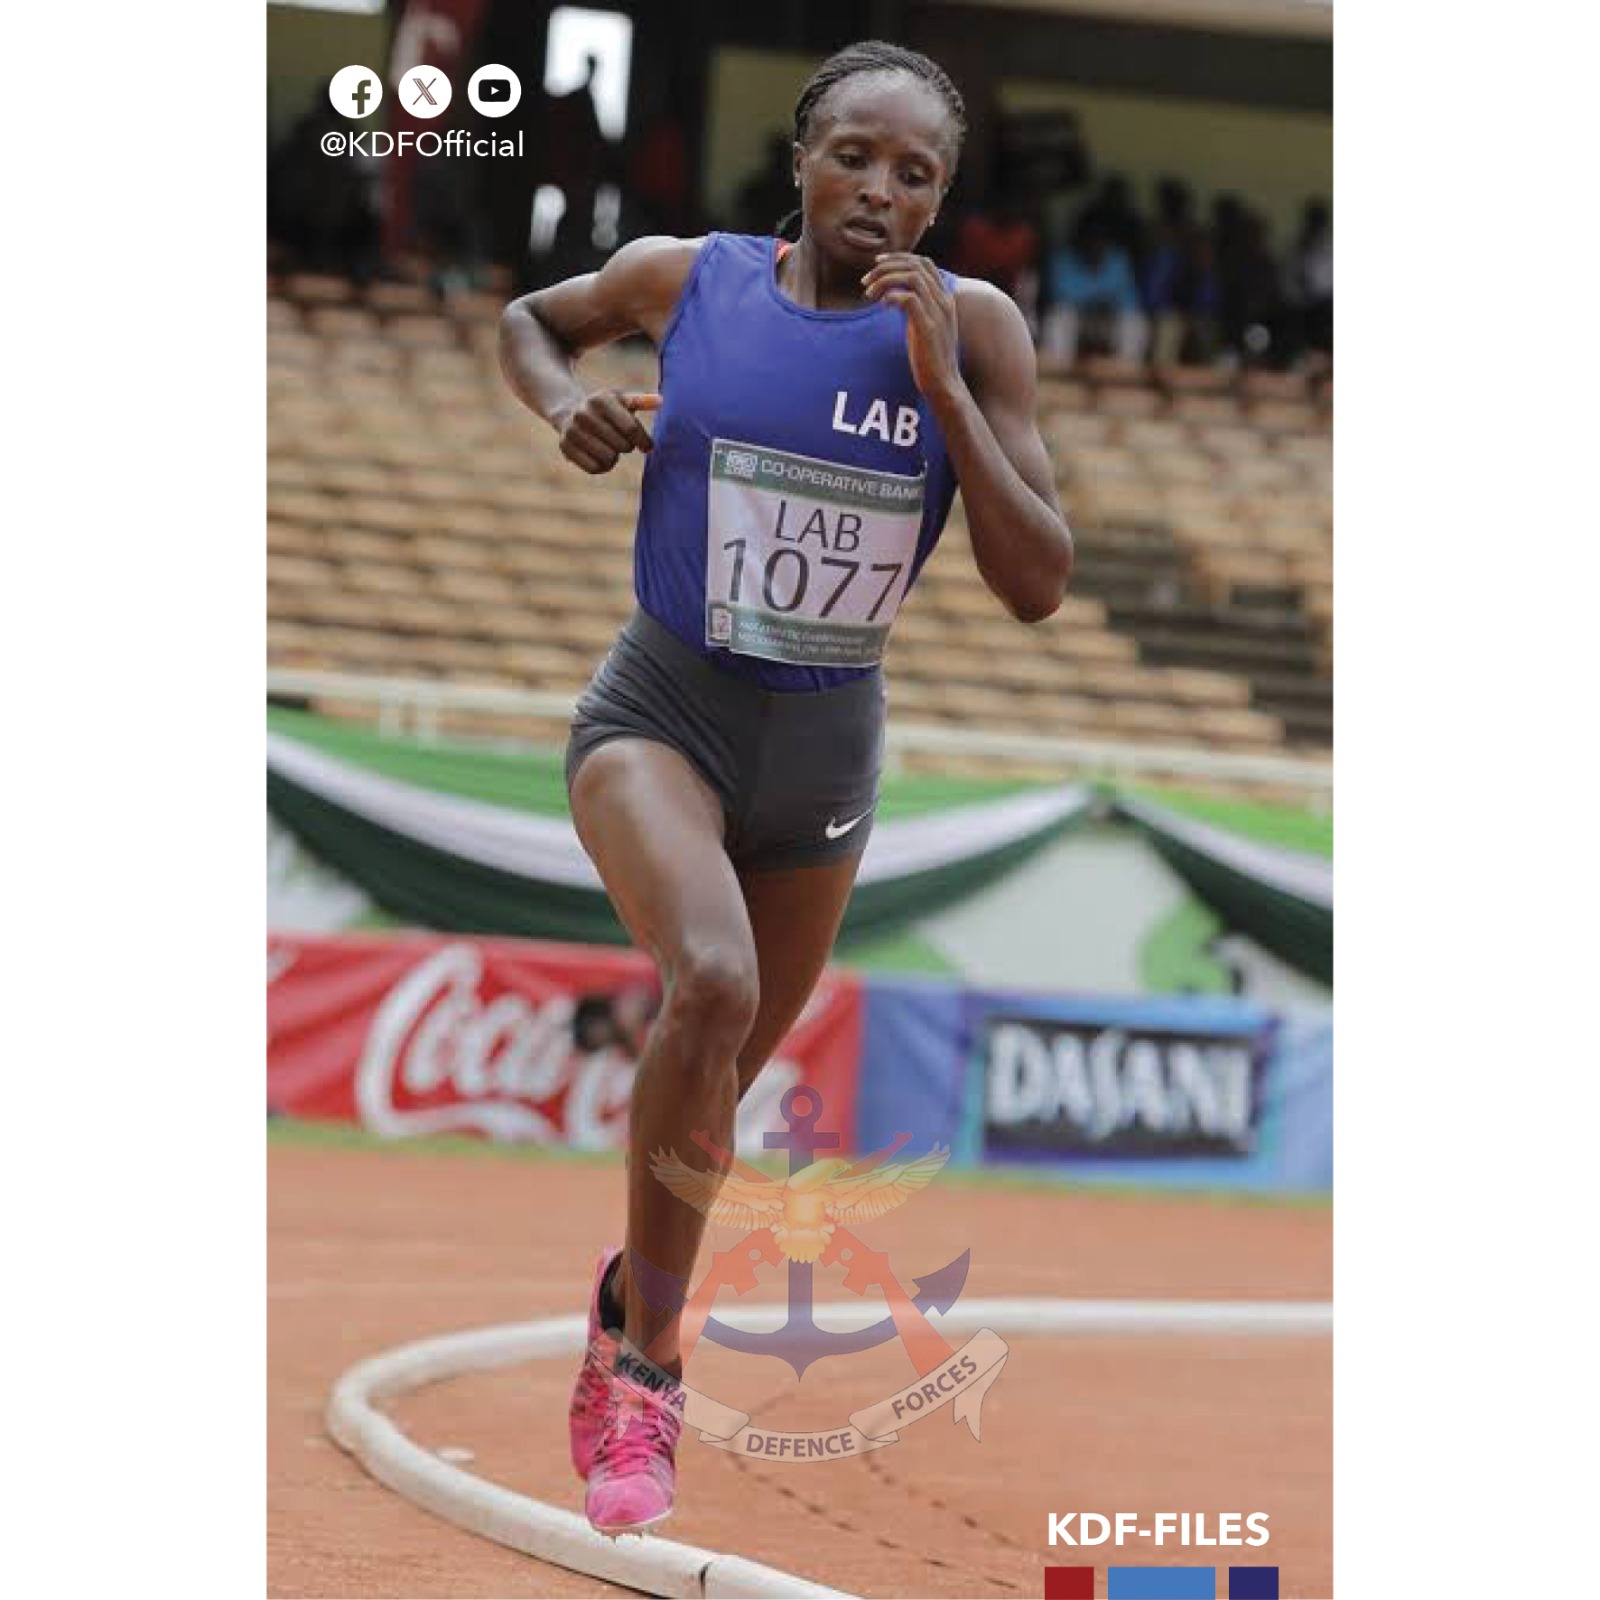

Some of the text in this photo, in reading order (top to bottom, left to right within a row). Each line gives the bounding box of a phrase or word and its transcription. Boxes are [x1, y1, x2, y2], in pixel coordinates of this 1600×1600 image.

[832, 391, 920, 447] LAB
[761, 459, 877, 496] CO-OPERATIVE
[775, 500, 862, 553] LAB
[723, 538, 902, 622] 1077
[989, 1022, 1252, 1143] DASANI
